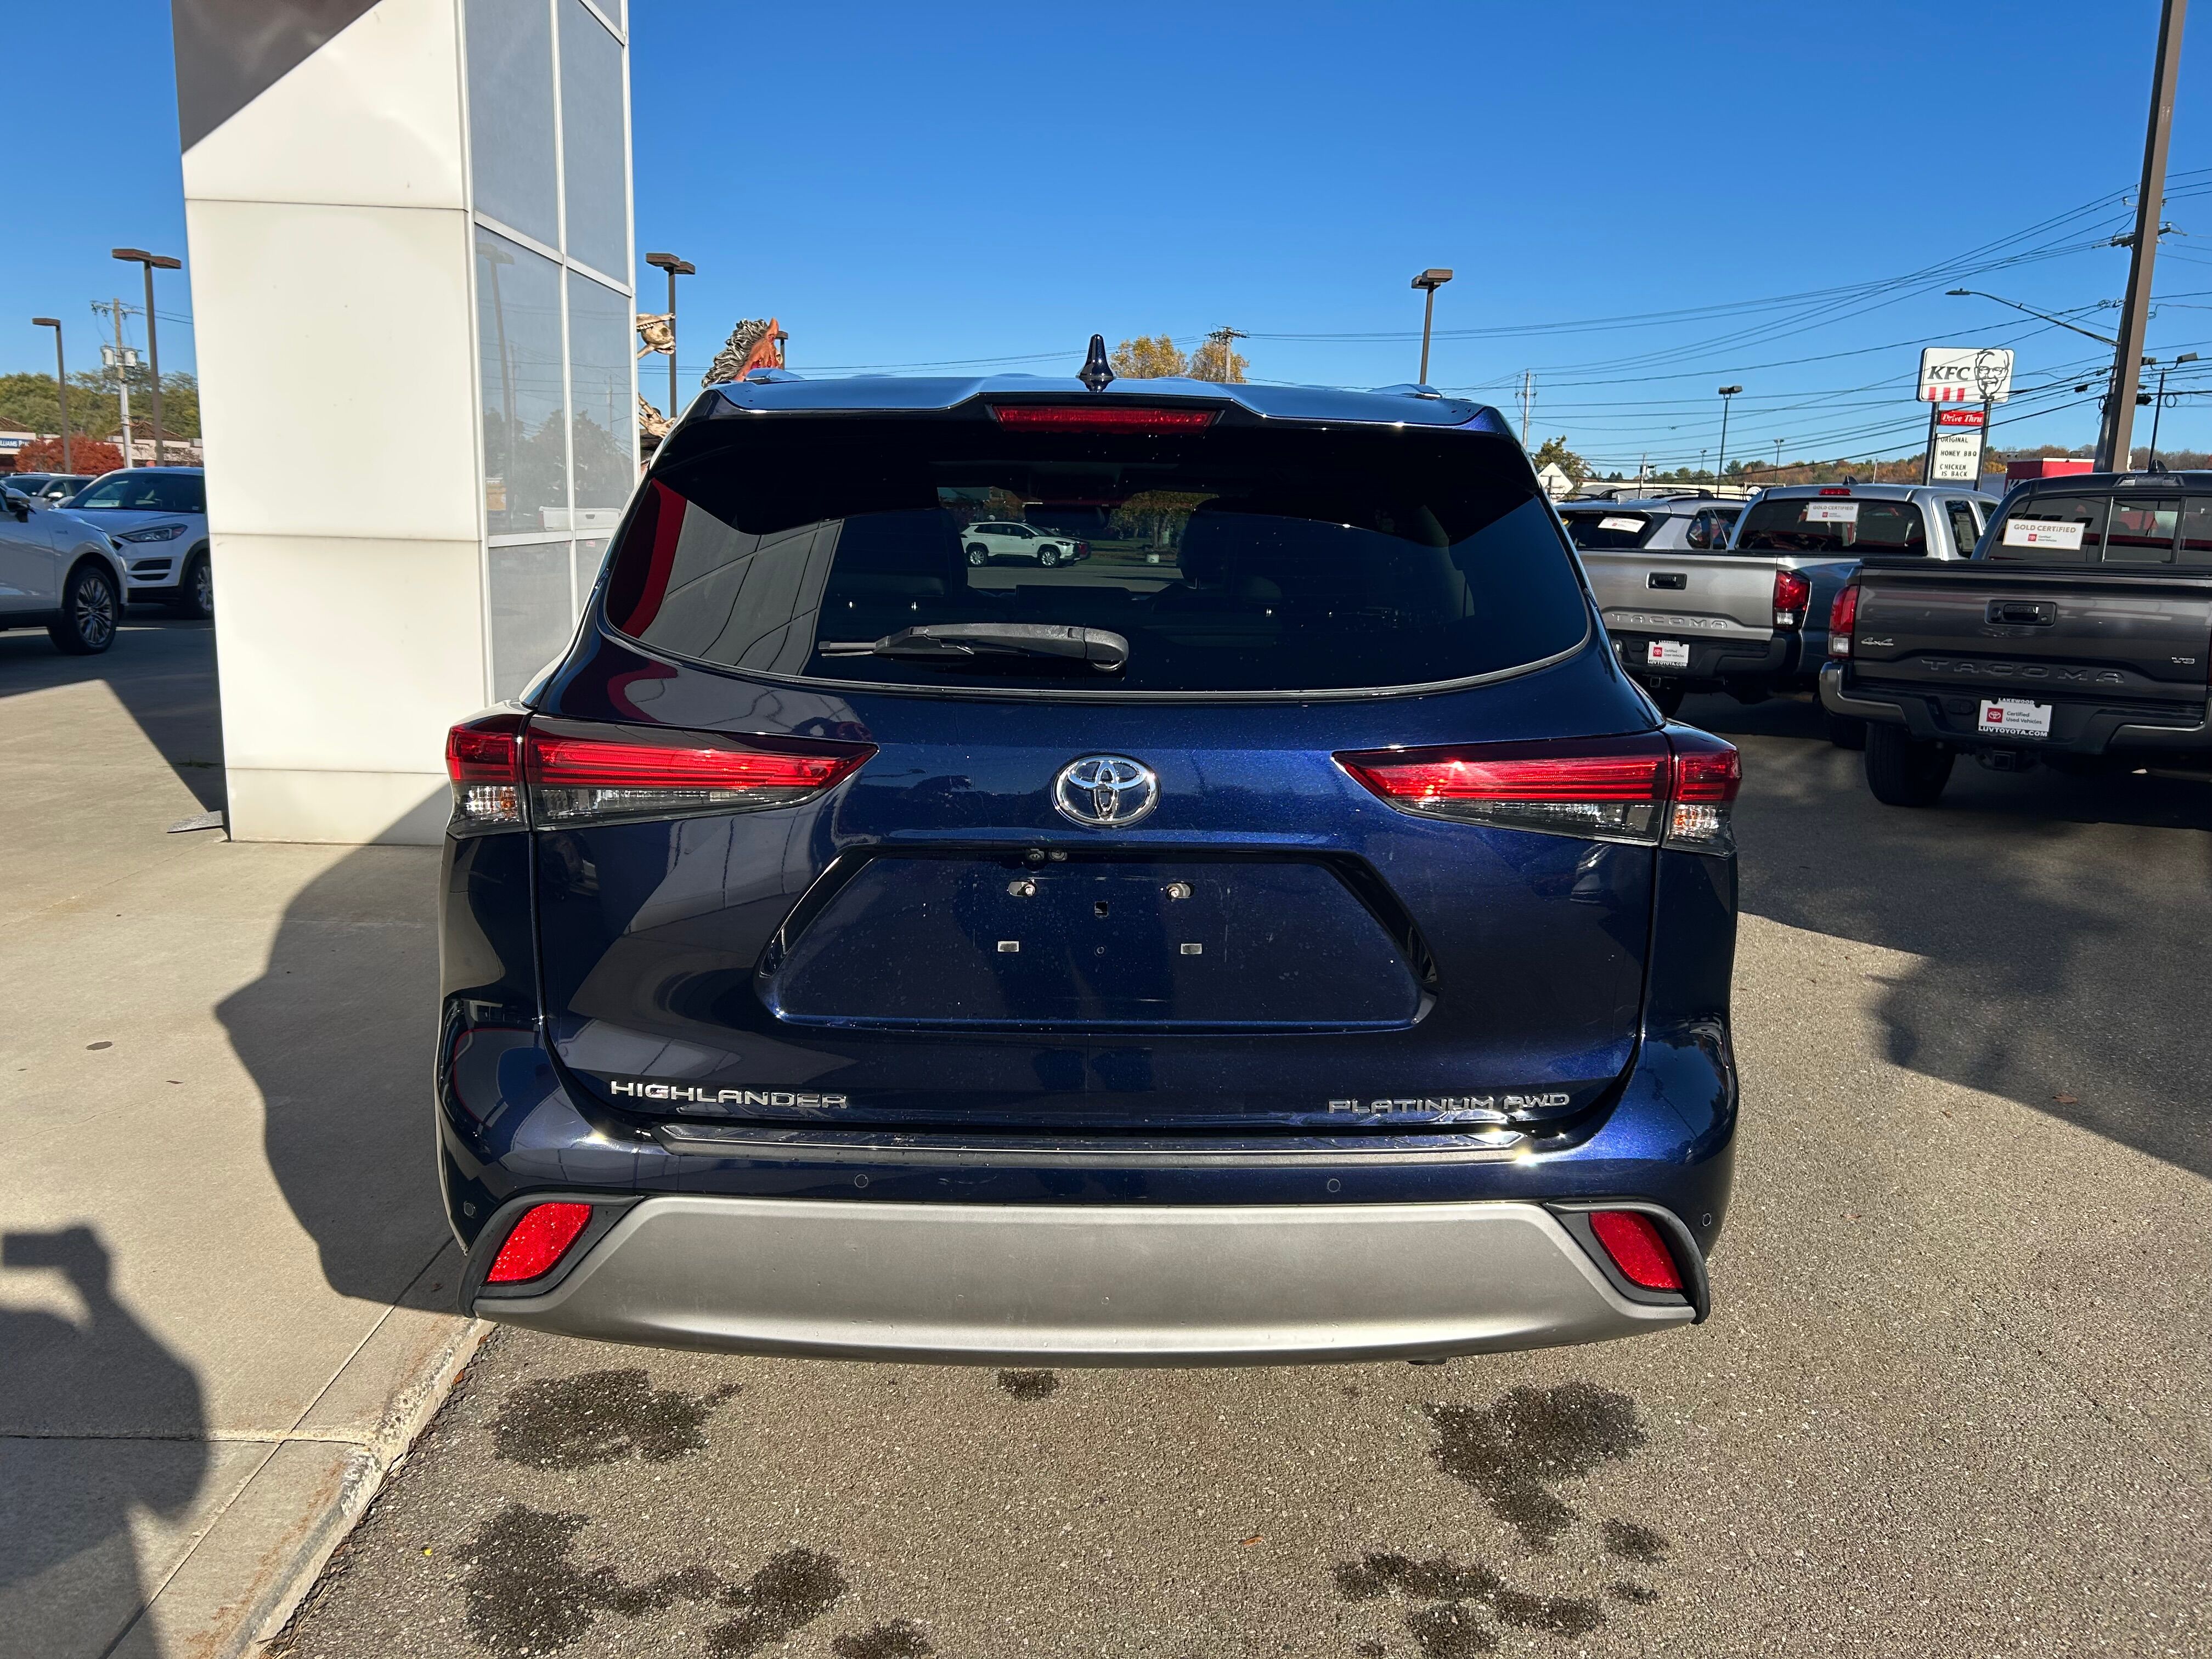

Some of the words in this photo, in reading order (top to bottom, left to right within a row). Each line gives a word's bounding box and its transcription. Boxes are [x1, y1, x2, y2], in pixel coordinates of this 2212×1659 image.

[1927, 366, 1971, 380] KFC
[1943, 413, 1962, 422] Drive
[1964, 414, 1983, 423] Thru
[2037, 525, 2076, 533] CERTIFIED
[1611, 613, 1728, 629] TACOMA
[1921, 658, 2125, 684] TACOMA
[1978, 725, 2047, 737] LUVTOYOTA.COM
[611, 1081, 848, 1109] HIGHLANDER
[1328, 1097, 1494, 1114] PLATINUM
[1503, 1093, 1570, 1110] AWD
